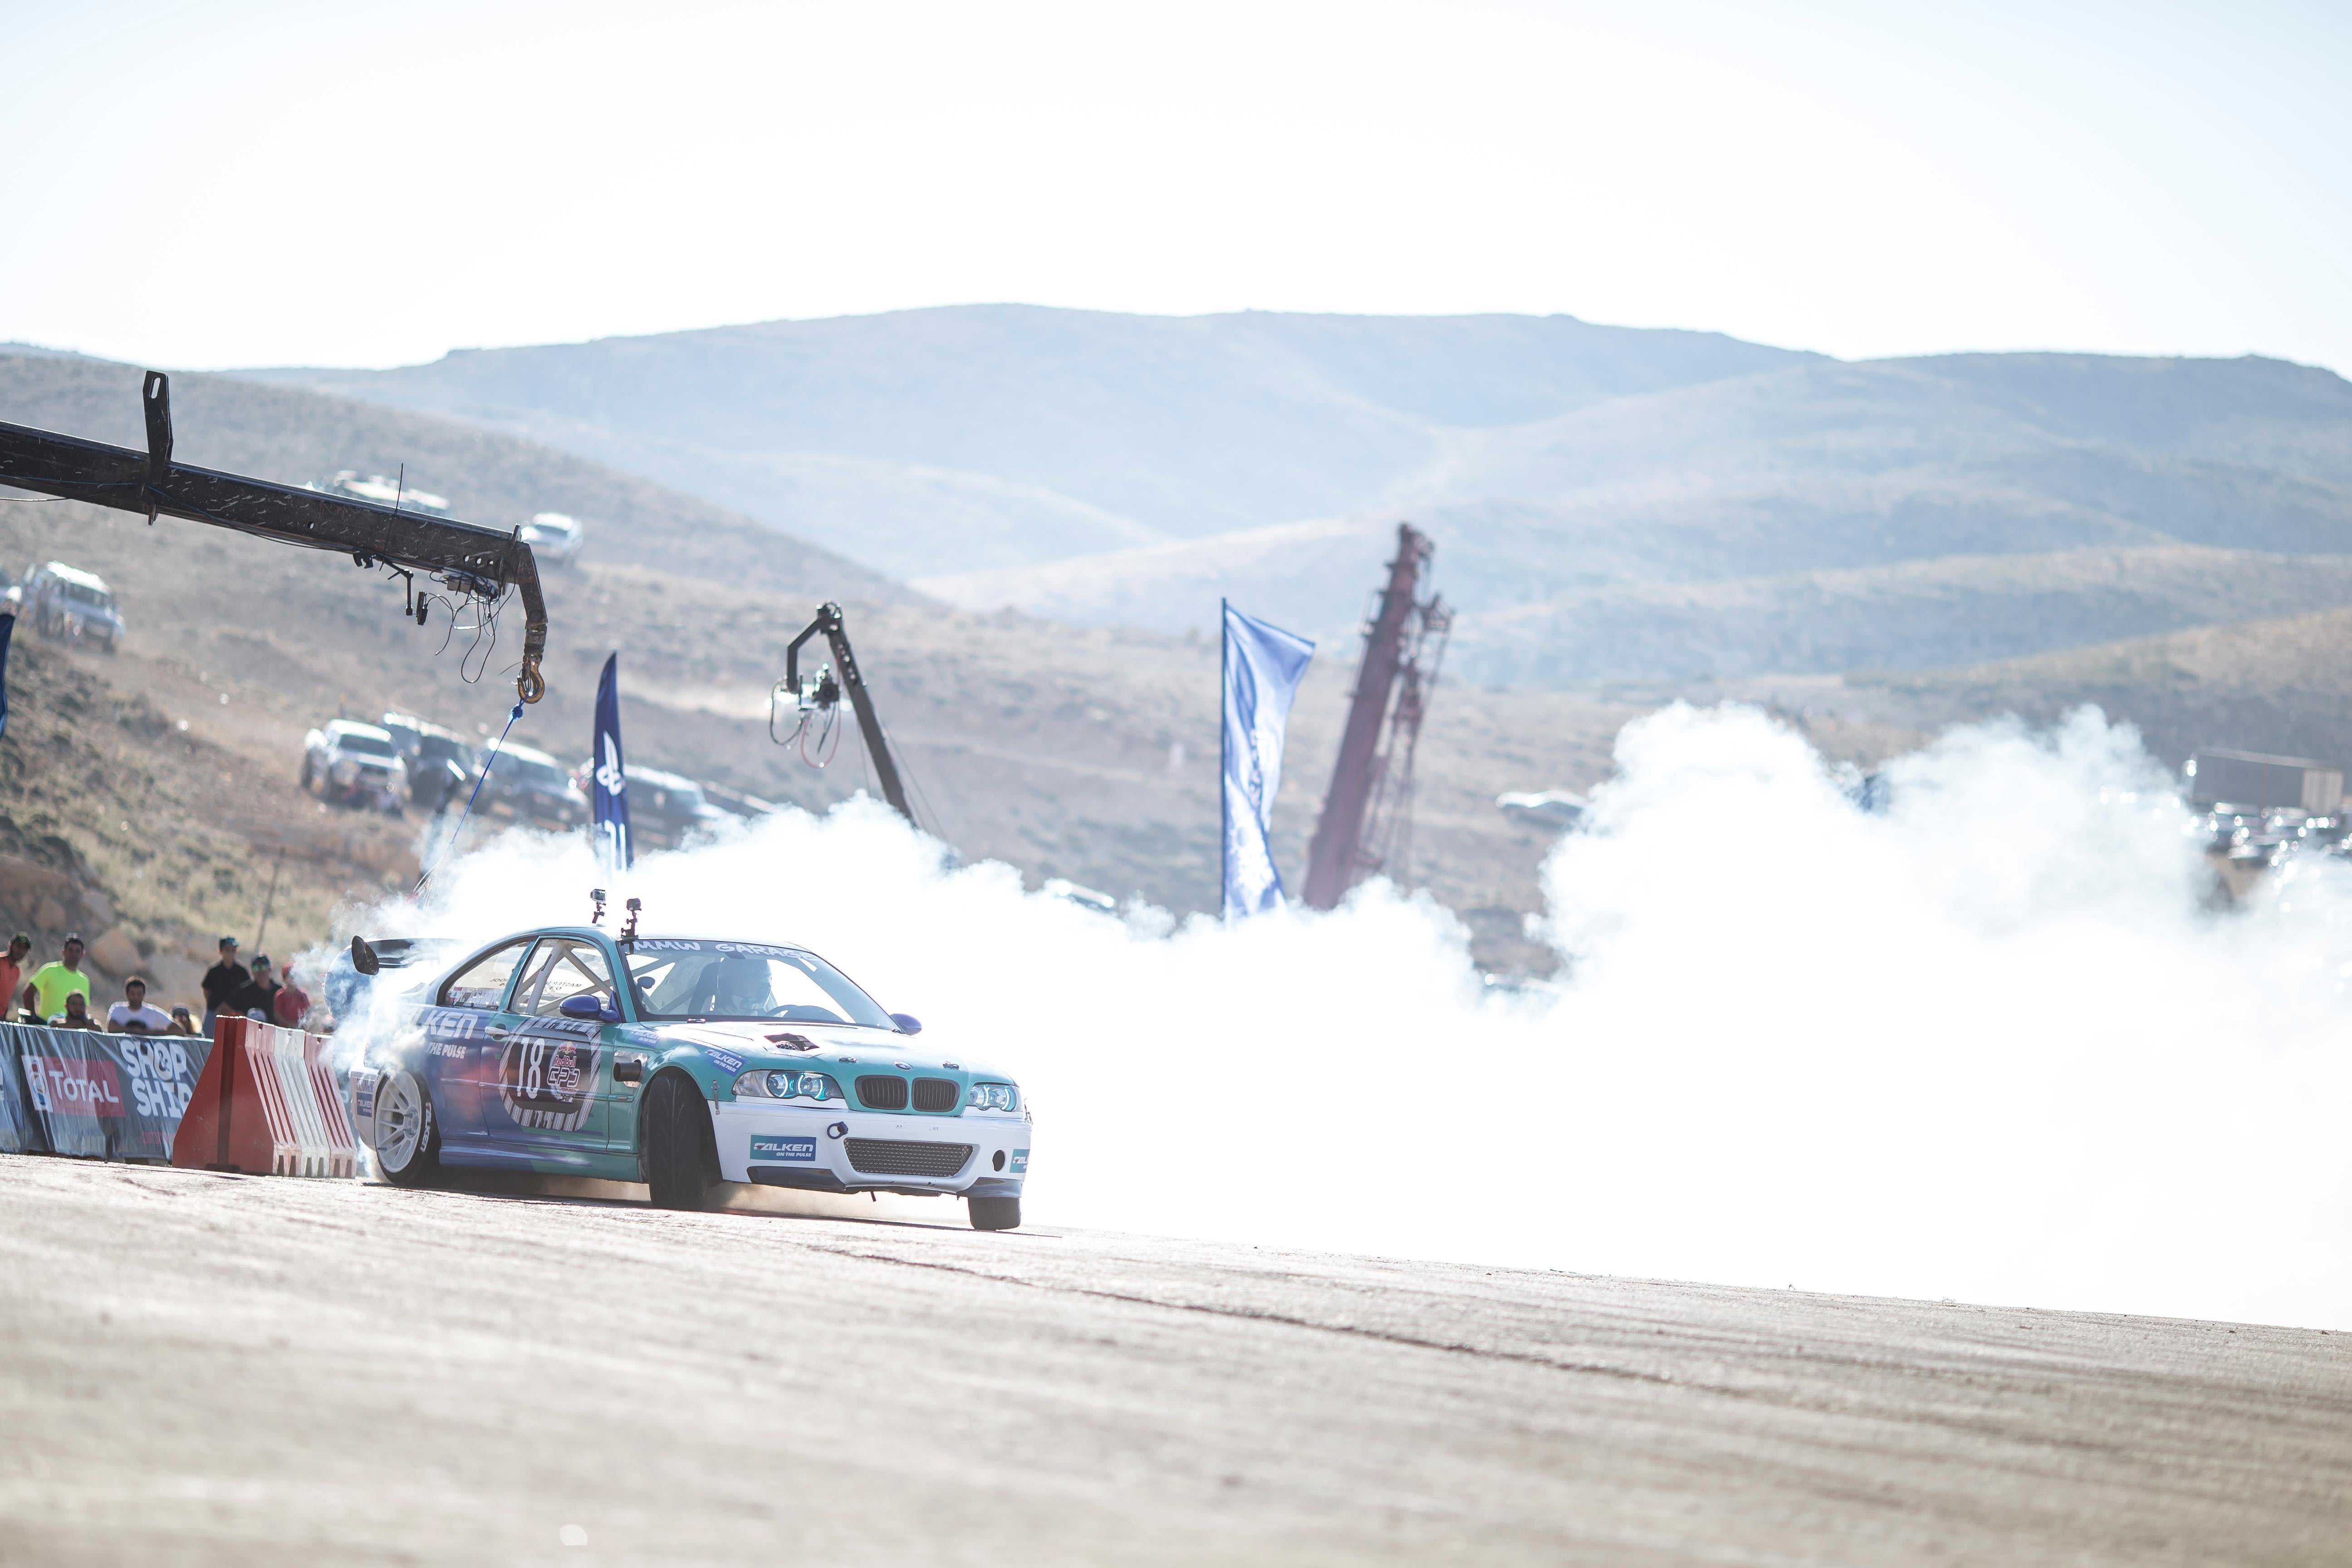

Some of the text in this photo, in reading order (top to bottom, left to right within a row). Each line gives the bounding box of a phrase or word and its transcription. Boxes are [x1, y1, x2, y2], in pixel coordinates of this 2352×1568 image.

[633, 941, 818, 961] MMW GARAGE
[120, 1039, 187, 1081] SHOP
[442, 1044, 466, 1059] PULSE
[704, 1049, 742, 1068] FALKEN
[517, 1037, 545, 1099] 18
[48, 1070, 119, 1103] TOTAL
[132, 1078, 193, 1119] SHIP
[753, 1142, 813, 1152] FALKEN
